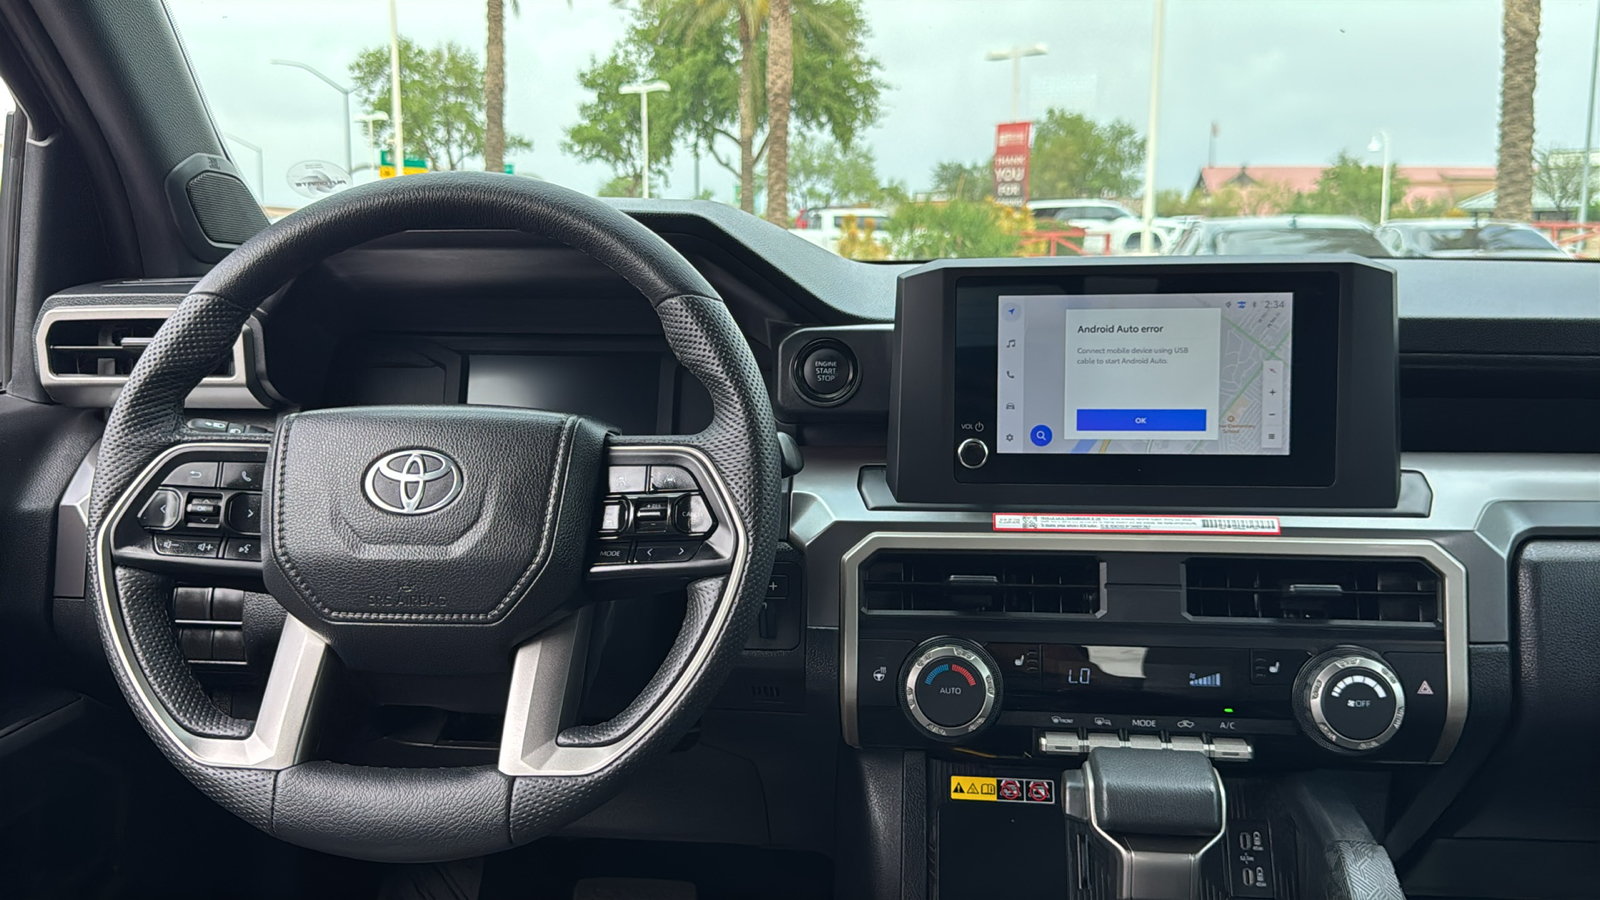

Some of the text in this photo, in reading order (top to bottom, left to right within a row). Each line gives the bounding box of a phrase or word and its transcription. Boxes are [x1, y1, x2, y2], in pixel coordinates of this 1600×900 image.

[994, 167, 1025, 182] YOU
[997, 182, 1020, 196] FOR
[1264, 300, 1285, 309] 2:34
[1077, 324, 1164, 334] Android Auto error
[1076, 346, 1189, 356] Connect mobile device using USB
[1076, 357, 1096, 365] cable
[1104, 357, 1121, 365] start
[1120, 357, 1149, 365] Android
[1149, 357, 1168, 365] Auto.
[1134, 417, 1147, 425] OK
[1067, 667, 1091, 685] LO
[939, 687, 962, 695] AUTO
[1355, 700, 1371, 708] OFF
[1131, 719, 1156, 727] MODE
[1219, 721, 1236, 730] A/C
